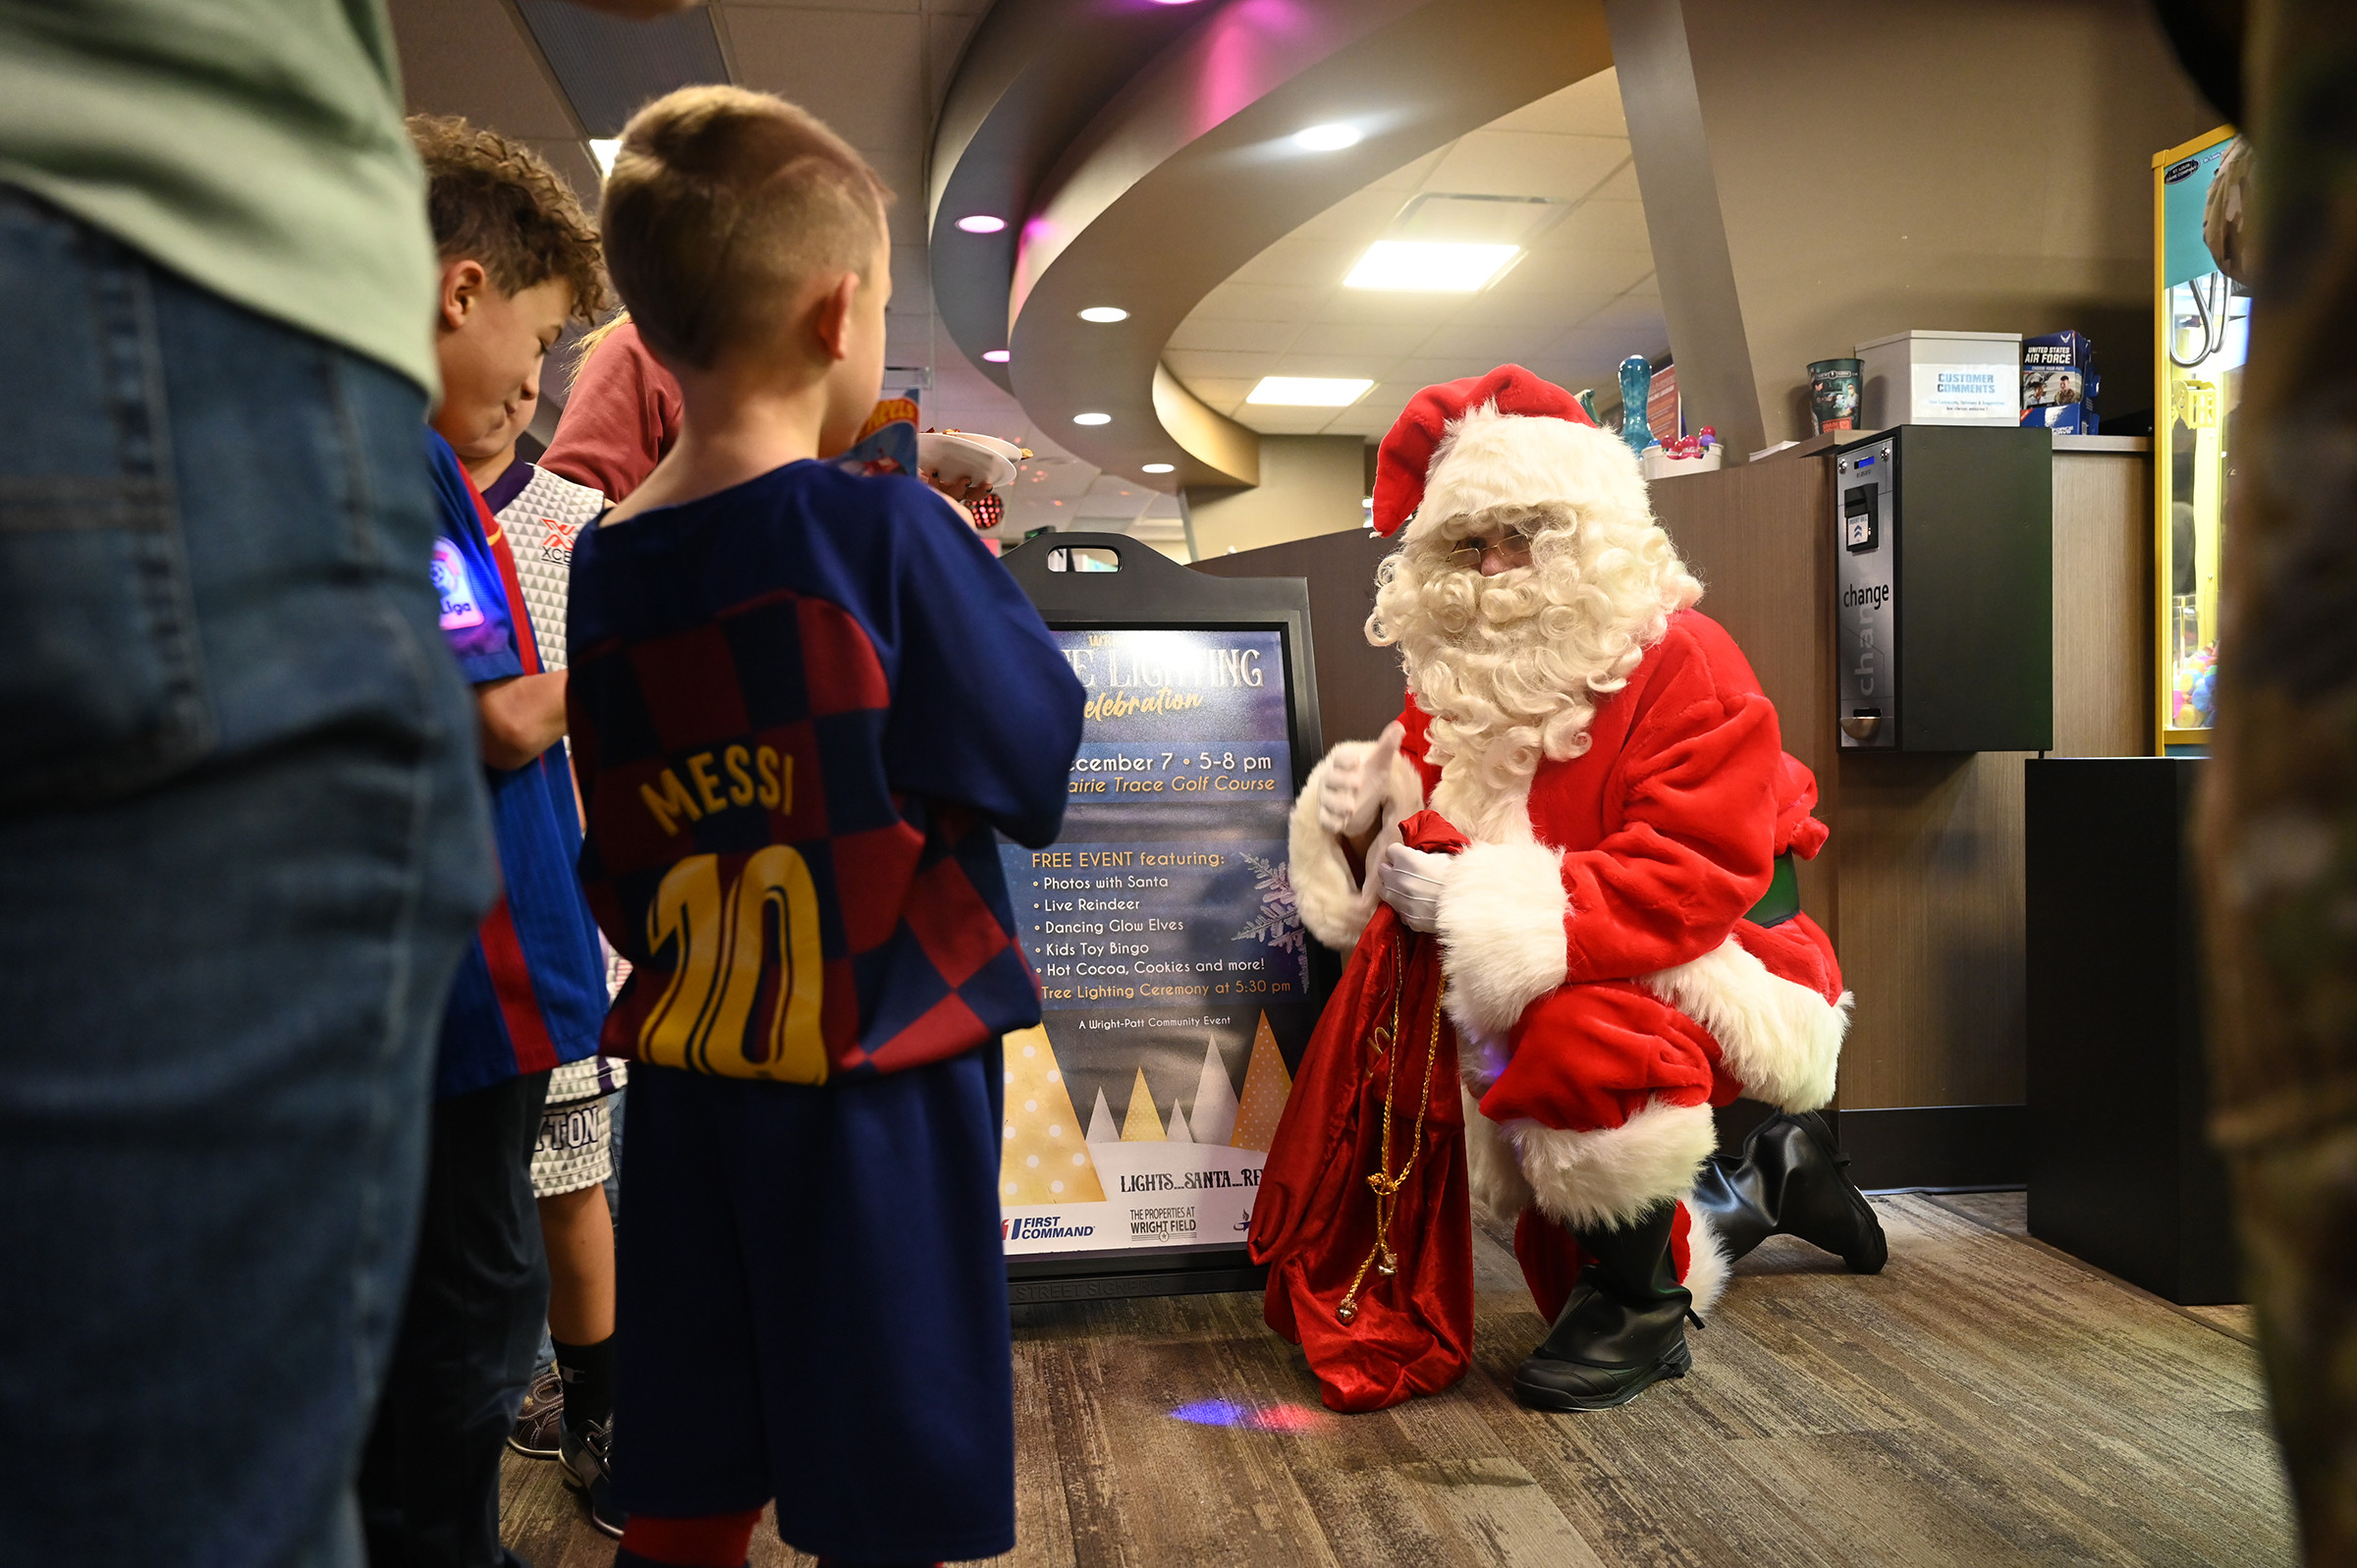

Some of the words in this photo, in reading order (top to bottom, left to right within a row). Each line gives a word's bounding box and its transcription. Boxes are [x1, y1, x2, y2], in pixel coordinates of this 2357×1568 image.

[2024, 353, 2040, 363] AIR
[2041, 353, 2071, 364] FORCE
[1938, 373, 1994, 383] CUSTOMER
[1937, 383, 1996, 394] COMMENTS
[542, 546, 573, 563] XCE
[1843, 584, 1890, 611] change
[1084, 686, 1204, 722] elebration
[1069, 753, 1153, 772] cember
[1161, 753, 1173, 770] 7
[1199, 752, 1235, 770] 5-8
[1243, 755, 1273, 773] pm
[639, 745, 795, 835] MESSI
[1069, 777, 1106, 793] airie
[1115, 777, 1164, 792] Trace
[1172, 776, 1209, 791] Golf
[1215, 776, 1276, 791] Course
[1032, 852, 1071, 868] FREE
[1079, 852, 1133, 867] EVENT
[1139, 852, 1226, 869] featuring:
[1044, 877, 1091, 891] Photos
[1095, 877, 1123, 890] with
[1127, 876, 1169, 889] Santa
[1044, 898, 1073, 912] Live
[1078, 897, 1140, 911] Reindeer
[1045, 920, 1104, 936] Dancing
[1109, 919, 1144, 934] Glow
[1149, 918, 1184, 933] Elves
[1046, 943, 1075, 957] Kids
[1079, 943, 1105, 958] Toy
[1110, 942, 1150, 958] Bingo
[637, 844, 829, 1087] 10
[1047, 963, 1072, 978] Hot
[1075, 962, 1130, 979] Cocoa,
[1134, 961, 1191, 975] Cookies
[1195, 959, 1224, 973] and
[1228, 957, 1265, 972] more!
[1041, 985, 1072, 1000] Tree
[1077, 983, 1135, 1001] Lighting
[1140, 982, 1210, 999] Ceremony
[1215, 982, 1231, 995] at
[1235, 979, 1268, 995] 5:30
[1271, 980, 1292, 995] pm
[1078, 1021, 1087, 1031] A
[1088, 1017, 1145, 1033] Wright-Patt
[1148, 1017, 1201, 1029] Community
[1203, 1015, 1232, 1027] Event
[1129, 1209, 1143, 1220] THE
[1144, 1207, 1184, 1219] PROPERTIES
[1185, 1206, 1196, 1217] AT
[1023, 1216, 1062, 1228] FIRST
[1130, 1221, 1169, 1235] WRIGHT
[1170, 1219, 1197, 1232] FIELD
[1021, 1226, 1094, 1240] COMMAND
[1015, 1284, 1083, 1301] STREET
